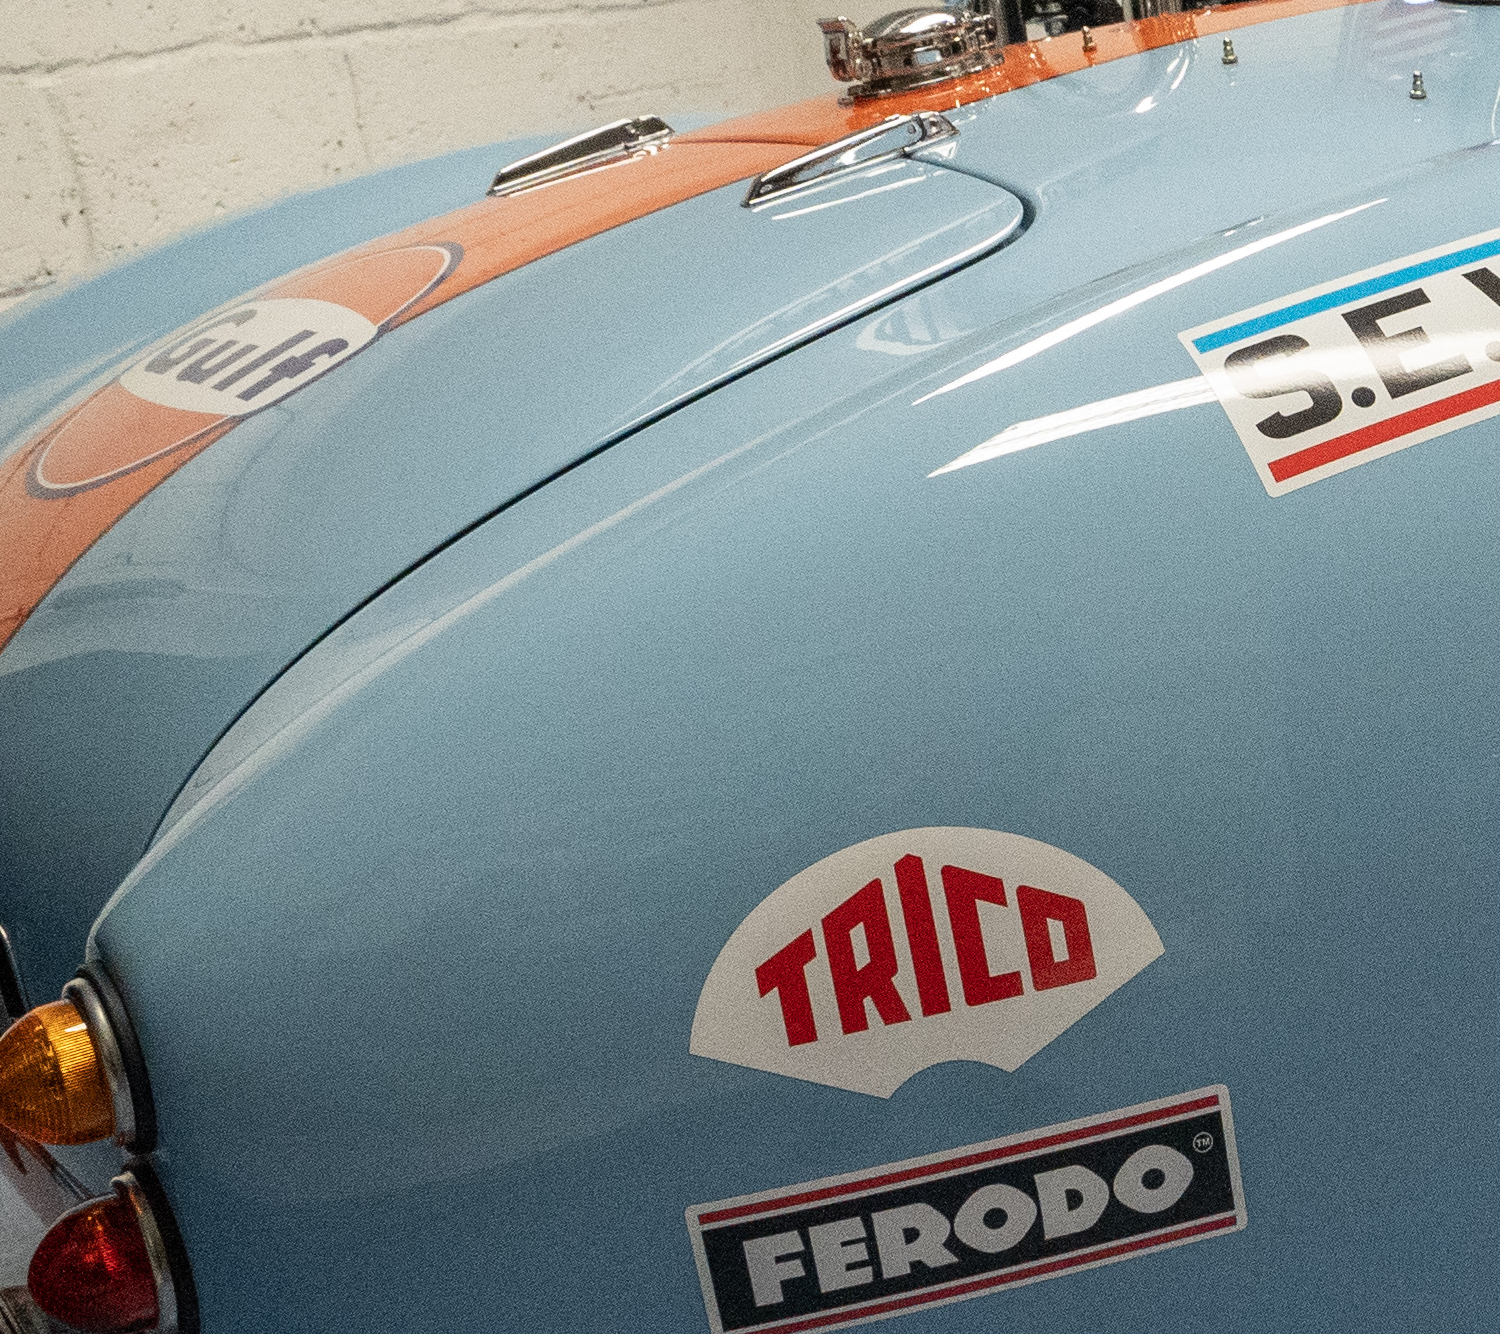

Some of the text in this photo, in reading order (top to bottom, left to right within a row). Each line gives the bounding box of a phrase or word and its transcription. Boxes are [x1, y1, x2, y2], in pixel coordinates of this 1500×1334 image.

[144, 308, 349, 402] Gulf
[754, 852, 1098, 1048] TRICO
[742, 1143, 1195, 1308] FERODO
